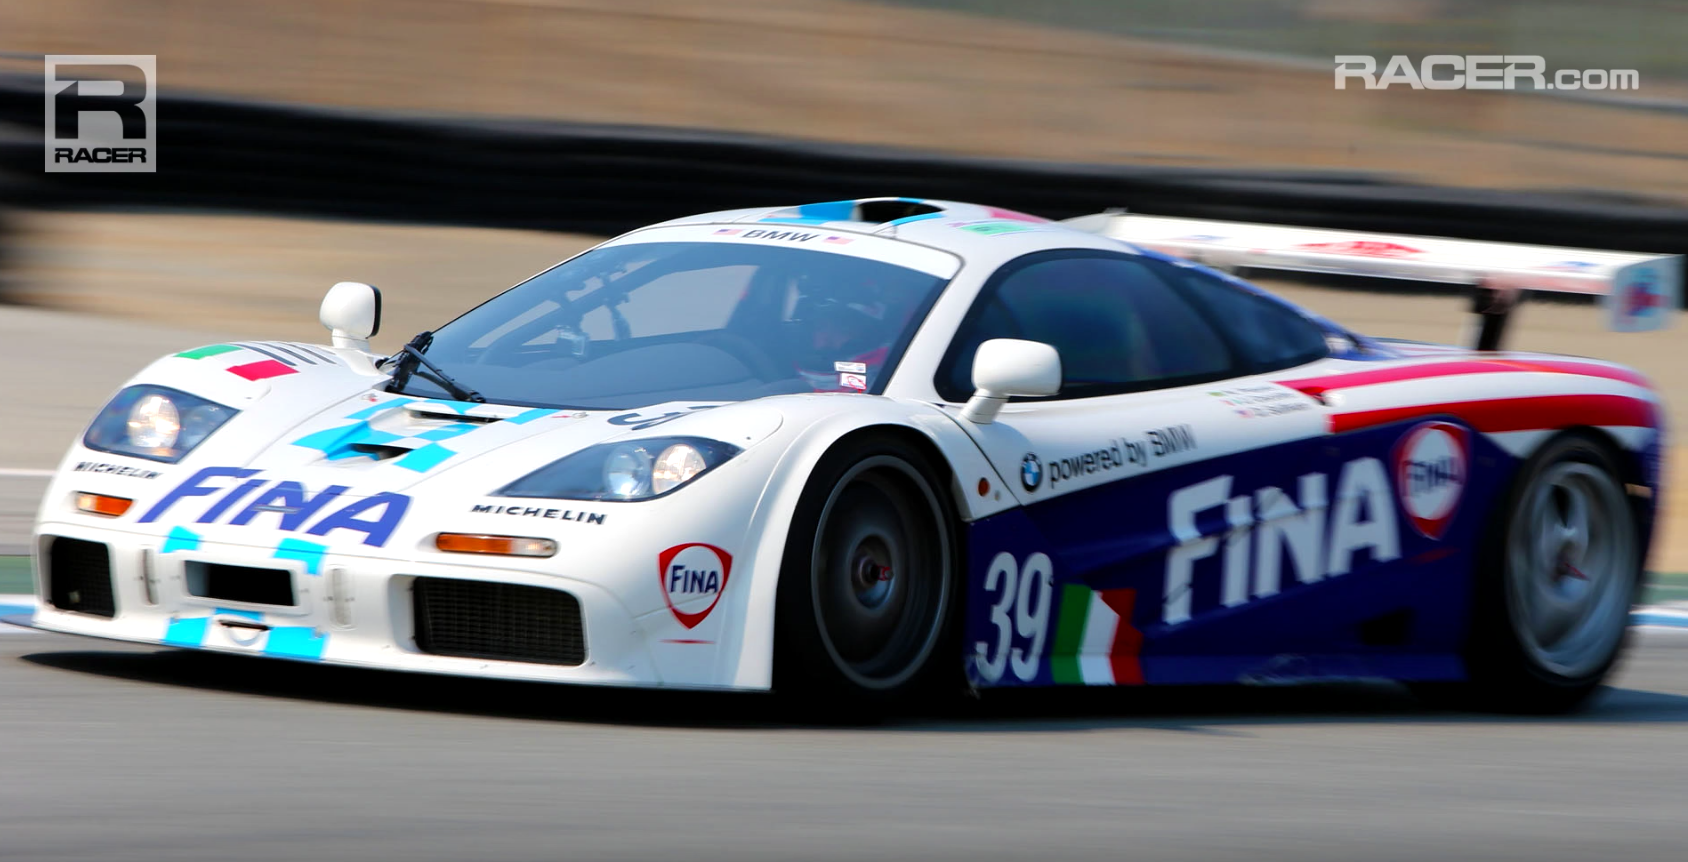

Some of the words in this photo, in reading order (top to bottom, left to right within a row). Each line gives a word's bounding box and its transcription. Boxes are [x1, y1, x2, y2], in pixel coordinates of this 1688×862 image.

[741, 229, 820, 242] BMW
[72, 461, 164, 480] MICHELIN
[1048, 438, 1124, 489] powered
[1121, 437, 1149, 467] by
[1147, 423, 1198, 457] BMW
[136, 466, 413, 548] FINA
[470, 503, 608, 526] MICHELIN
[1162, 456, 1402, 625] FINA
[669, 564, 720, 594] FINA
[975, 551, 1054, 683] 39
